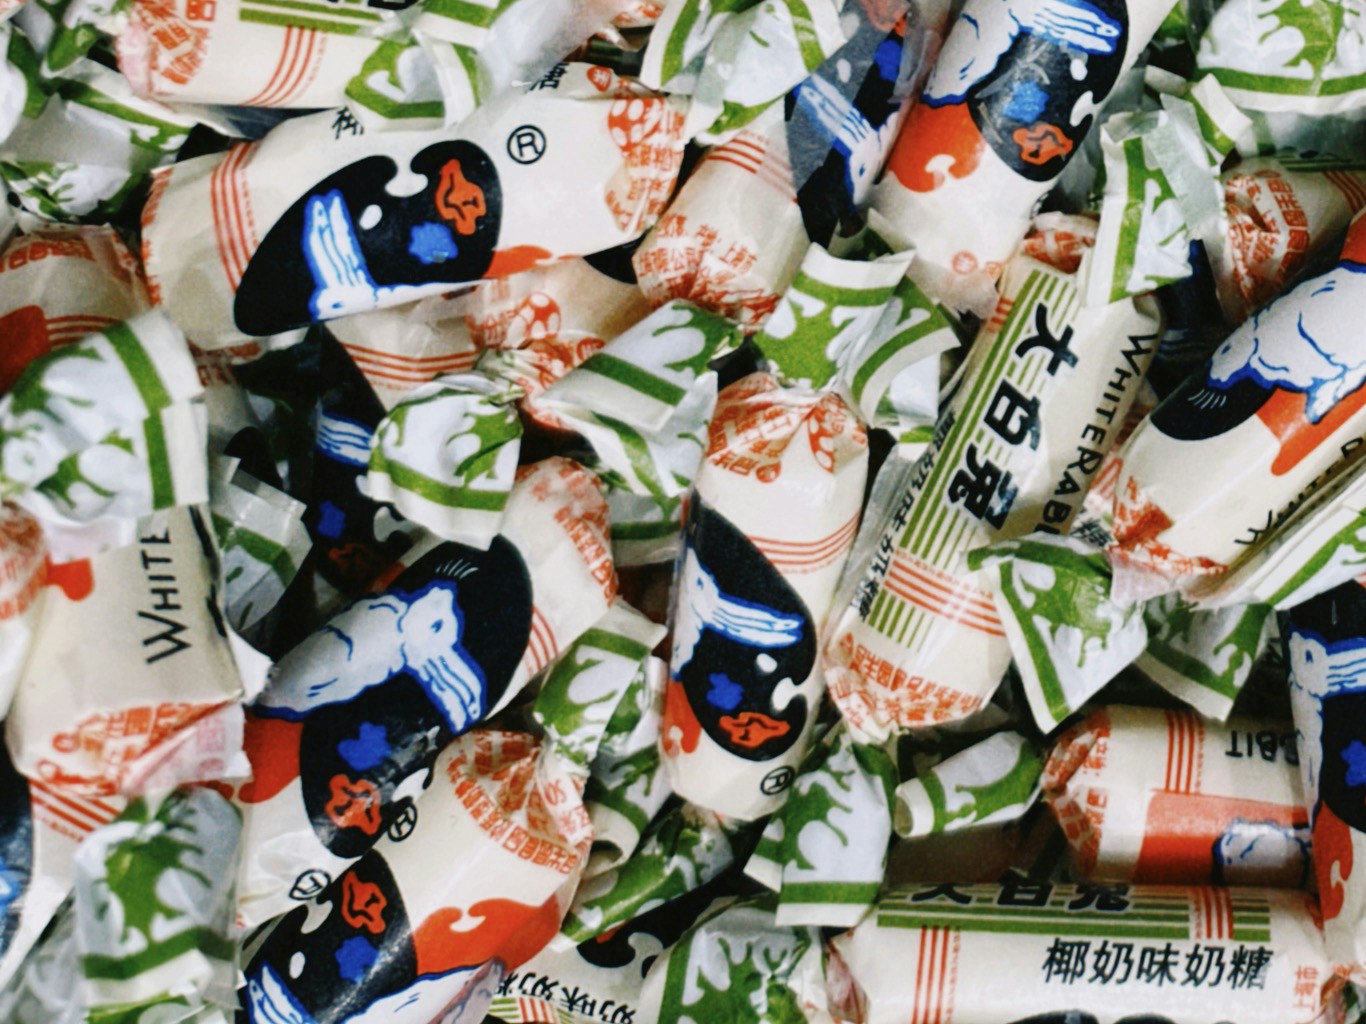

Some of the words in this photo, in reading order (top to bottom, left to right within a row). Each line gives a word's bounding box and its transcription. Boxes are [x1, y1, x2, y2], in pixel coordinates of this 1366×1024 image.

[949, 302, 1078, 528] 大白兔
[1041, 938, 1273, 990] 椰奶味奶糖
